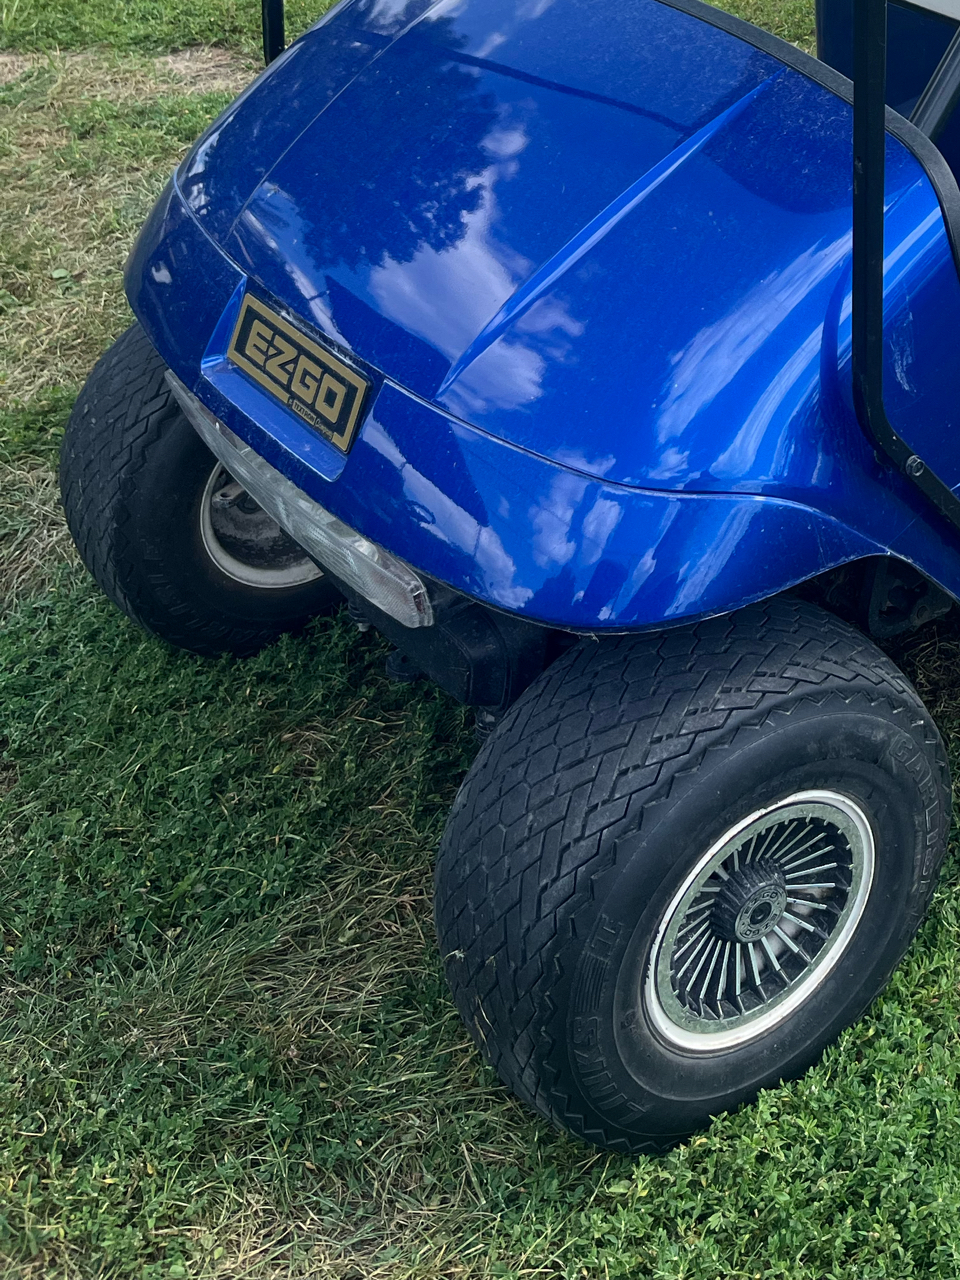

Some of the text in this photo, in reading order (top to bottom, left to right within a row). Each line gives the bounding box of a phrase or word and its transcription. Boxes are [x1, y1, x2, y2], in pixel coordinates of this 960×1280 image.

[245, 319, 347, 424] EZGO
[293, 401, 316, 423] TEXTRON
[573, 1017, 649, 1125] LINKS
